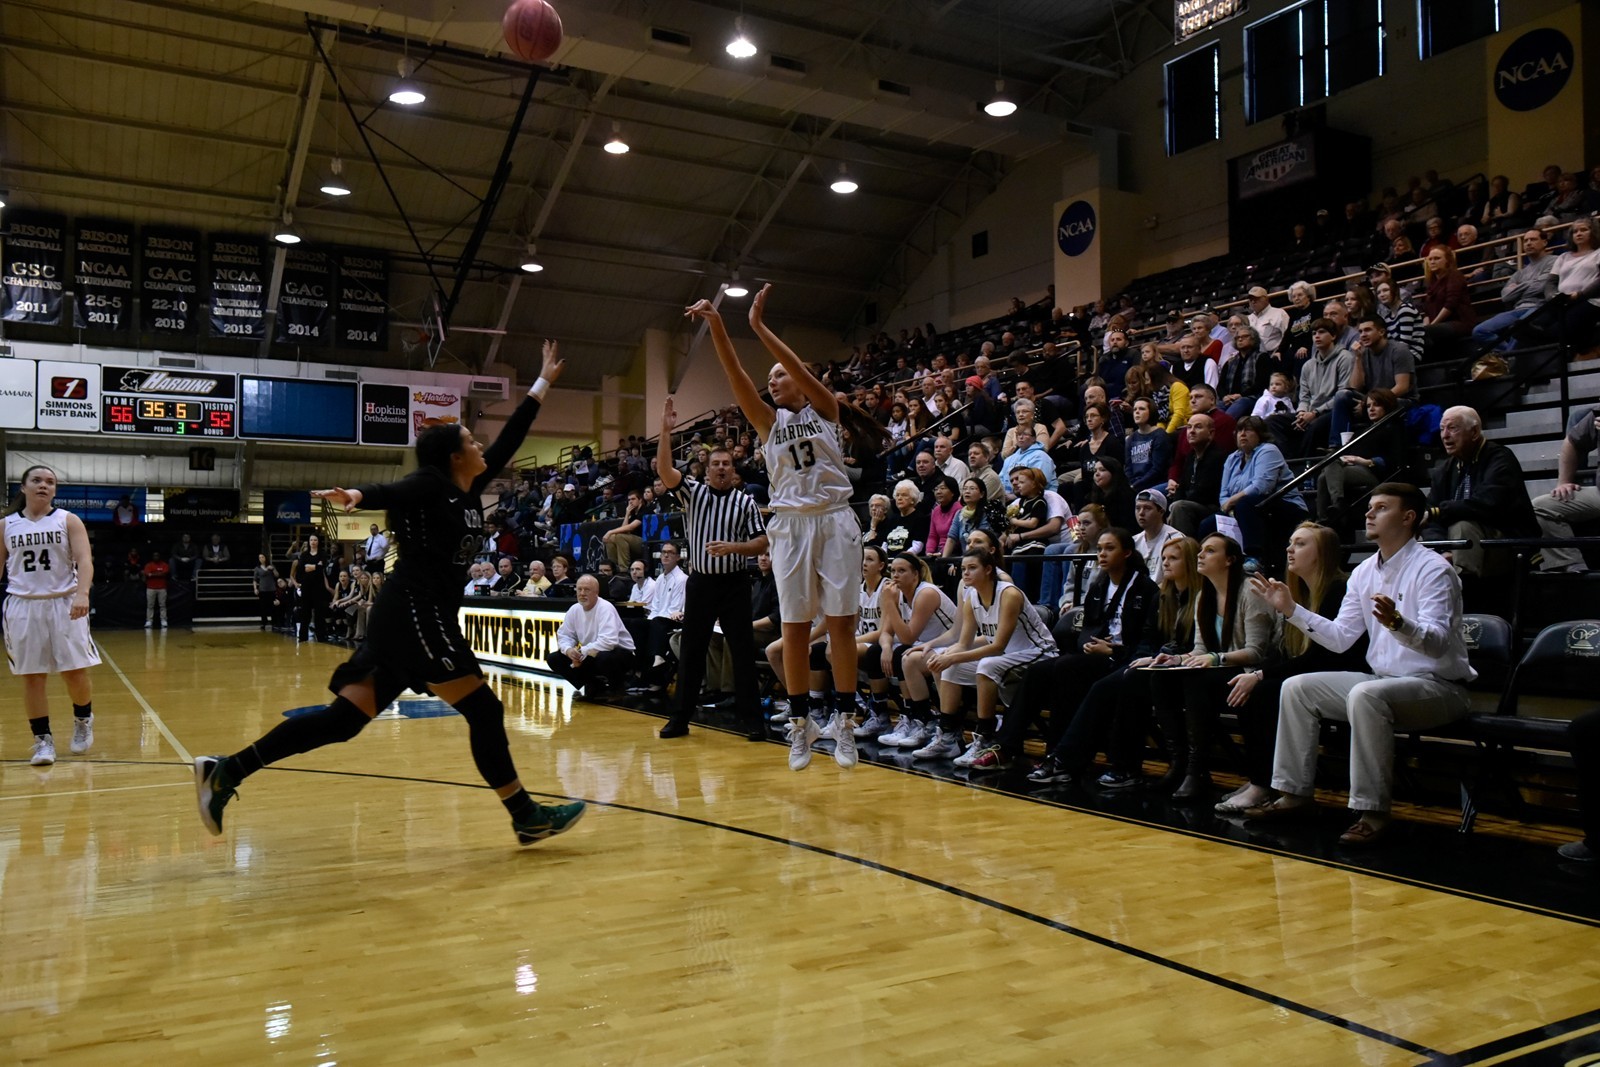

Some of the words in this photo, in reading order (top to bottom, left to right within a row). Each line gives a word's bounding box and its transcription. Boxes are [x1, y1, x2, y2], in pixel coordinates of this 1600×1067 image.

[1498, 52, 1568, 89] NCAA
[1258, 145, 1290, 162] GREAT
[1246, 150, 1305, 179] AMERICAN
[10, 223, 60, 239] BISON
[1060, 218, 1093, 240] NCAA
[80, 229, 128, 245] BISON
[7, 238, 62, 251] BASKETBALL
[77, 242, 131, 255] BASKETBALL
[147, 237, 193, 251] BISON
[215, 242, 259, 256] BISON
[145, 250, 196, 262] BASKETBALL
[212, 254, 262, 265] BASKETBALL
[80, 261, 128, 277] NCAA
[343, 256, 384, 270] BISON
[11, 262, 56, 278] GSC
[149, 266, 192, 282] GAC
[216, 269, 260, 282] NCAA
[340, 267, 385, 280] BASKETBALL
[3, 276, 62, 290] CHAMPIONS
[75, 275, 132, 289] TOURNAMENT
[144, 281, 196, 293] CHAMPIONS
[213, 282, 262, 293] TOURNAMENT
[285, 281, 324, 297] GAC
[343, 288, 383, 303] NCAA
[16, 301, 48, 314] 2011
[85, 294, 122, 308] 25-5
[152, 299, 188, 312] 22-10
[216, 297, 260, 308] REGIONAL
[281, 296, 328, 308] CHAMPIONS
[235, 307, 262, 318] FINALS
[339, 302, 386, 314] TOURNAMENT
[88, 312, 119, 324] 2011
[155, 317, 185, 330] 2013
[224, 323, 252, 334] 2013
[288, 323, 319, 337] 2014
[347, 329, 377, 342] 2014
[140, 371, 218, 394] HARDING
[45, 401, 93, 410] SIMMONS
[106, 397, 134, 406] HOME
[204, 402, 234, 411] VISITOR
[40, 409, 69, 418] FIRST
[70, 410, 97, 419] BANK
[111, 406, 133, 423] 56
[365, 402, 407, 416] Hopkins
[210, 411, 231, 428] 52
[364, 415, 407, 424] Orthodontics
[115, 424, 136, 432] BONUS
[154, 425, 174, 433] PERIOD
[176, 422, 185, 434] 3
[204, 428, 224, 436] BONUS
[775, 420, 823, 445] HARDING
[190, 450, 214, 470] 16
[788, 440, 816, 471] 13
[170, 508, 198, 517] Harding
[199, 508, 232, 518] University
[276, 511, 300, 519] NCAA
[10, 531, 62, 549] HARDING
[23, 549, 51, 572] 24
